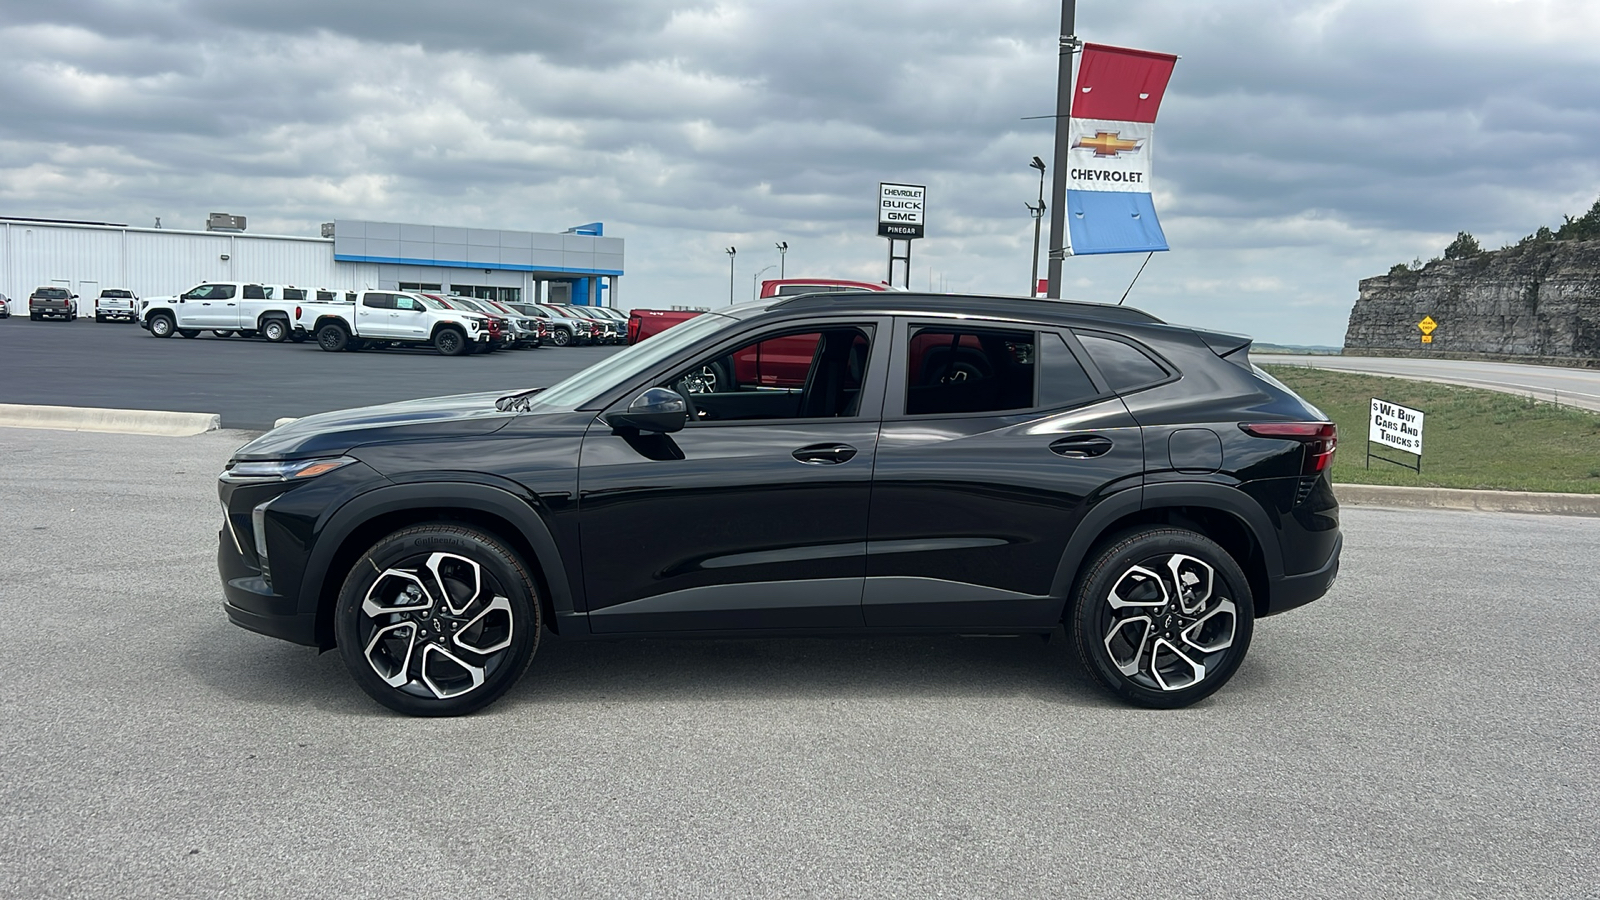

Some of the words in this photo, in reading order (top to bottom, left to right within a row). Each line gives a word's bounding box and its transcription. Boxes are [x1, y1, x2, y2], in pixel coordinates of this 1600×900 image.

[1070, 168, 1143, 183] CHEVROLET
[884, 188, 922, 198] CHEVROLET
[882, 200, 922, 210] BUICK
[887, 212, 917, 221] GMC
[887, 226, 916, 234] PINEGAR
[1380, 403, 1395, 417] WE
[414, 536, 459, 547] Continental
